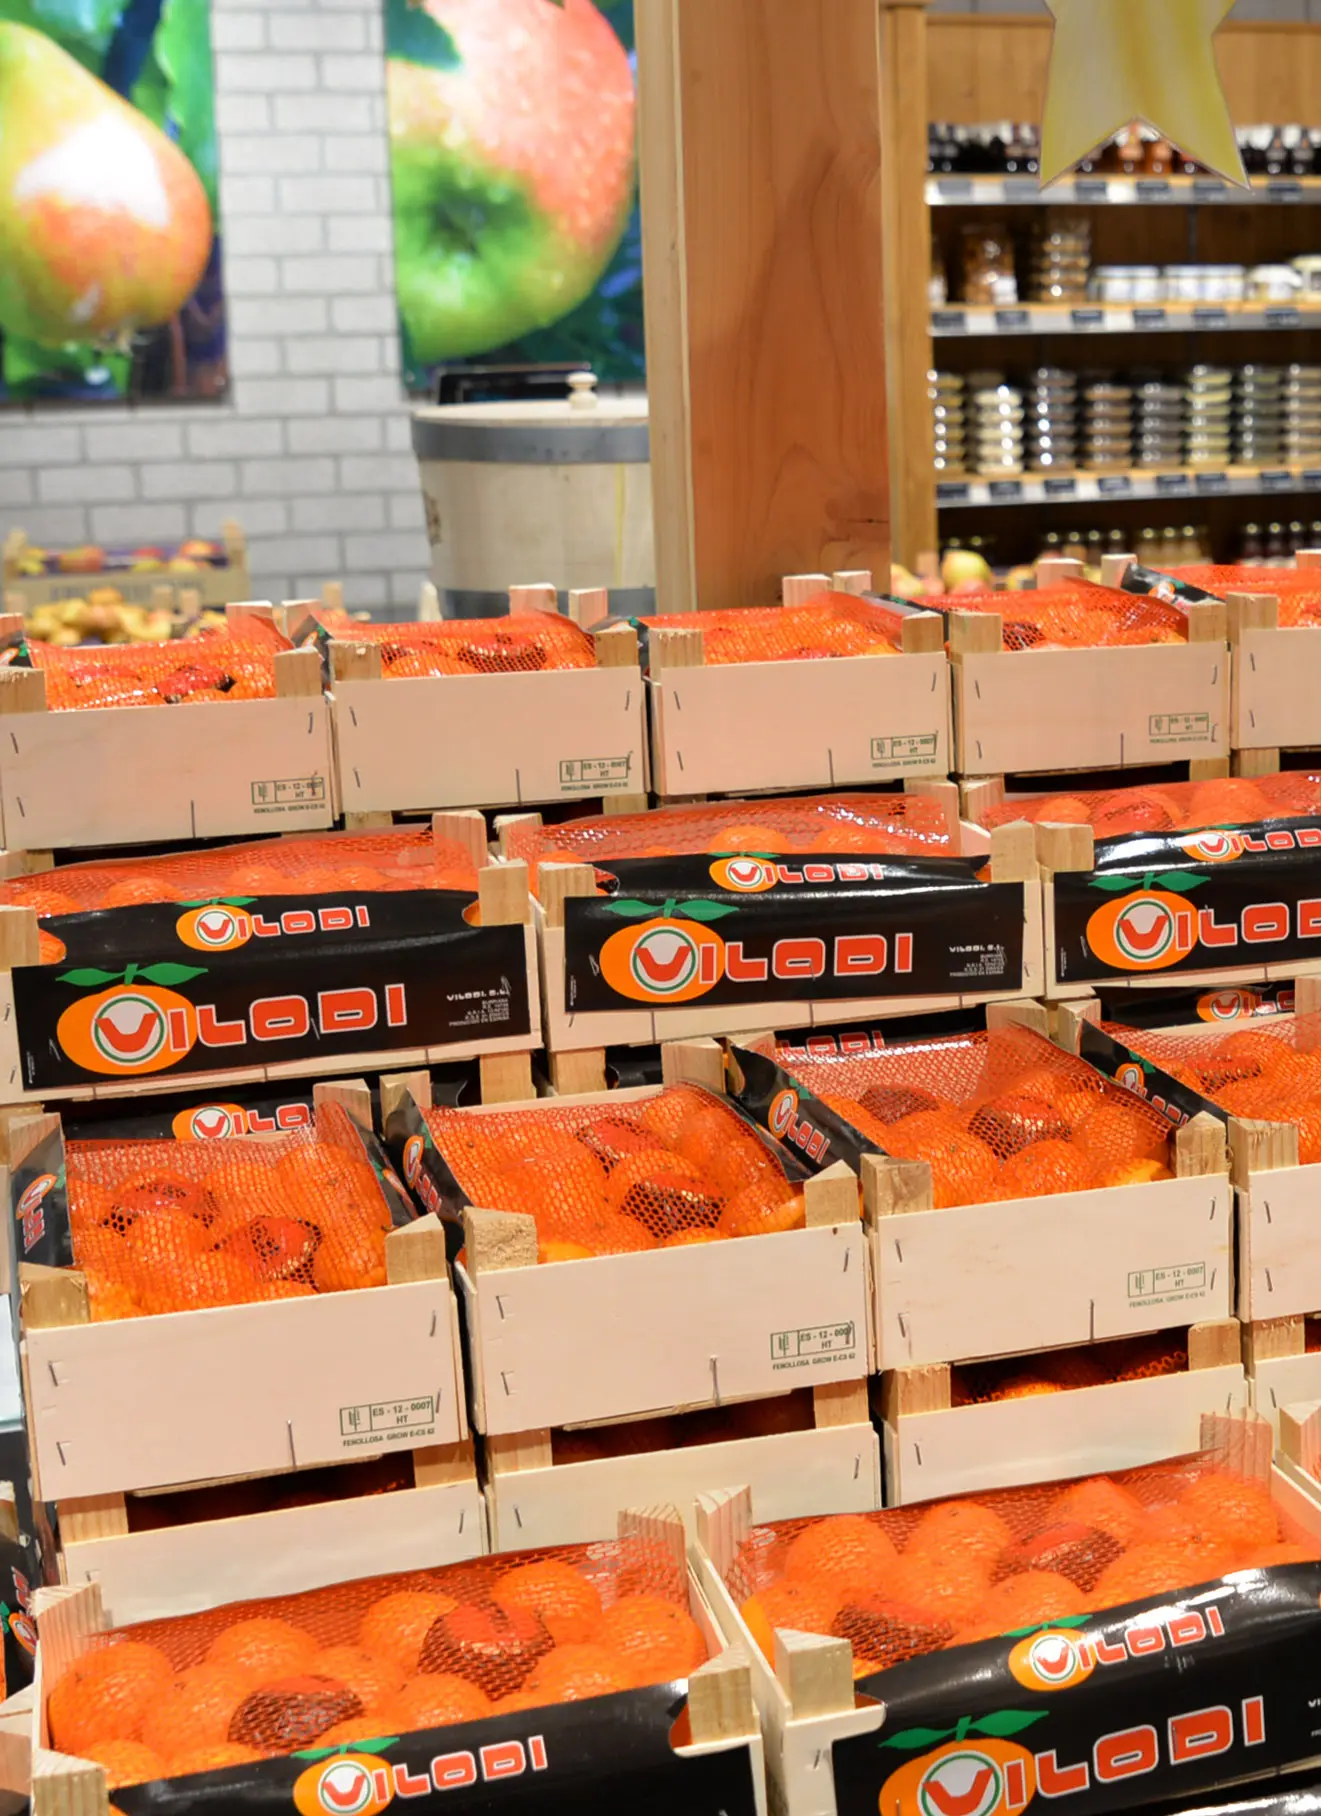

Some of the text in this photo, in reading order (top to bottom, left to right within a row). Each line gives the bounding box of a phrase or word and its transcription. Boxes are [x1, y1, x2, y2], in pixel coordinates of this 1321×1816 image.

[728, 862, 886, 889] VILODI
[198, 904, 371, 941] VILODI
[632, 932, 913, 992] VILODI
[94, 983, 408, 1054] VILODI
[193, 1103, 311, 1138] VILO
[800, 1332, 812, 1342] ES
[819, 1330, 828, 1339] 12
[821, 1340, 832, 1349] HT
[811, 1356, 832, 1365] GROW
[372, 1407, 385, 1417] ES
[393, 1404, 403, 1414] 12
[411, 1400, 431, 1411] 0007
[396, 1415, 408, 1425] HT
[386, 1431, 408, 1441] GROW
[1031, 1606, 1226, 1674] VILODI
[322, 1735, 549, 1807] VILODI
[922, 1695, 1266, 1816] VILODI
